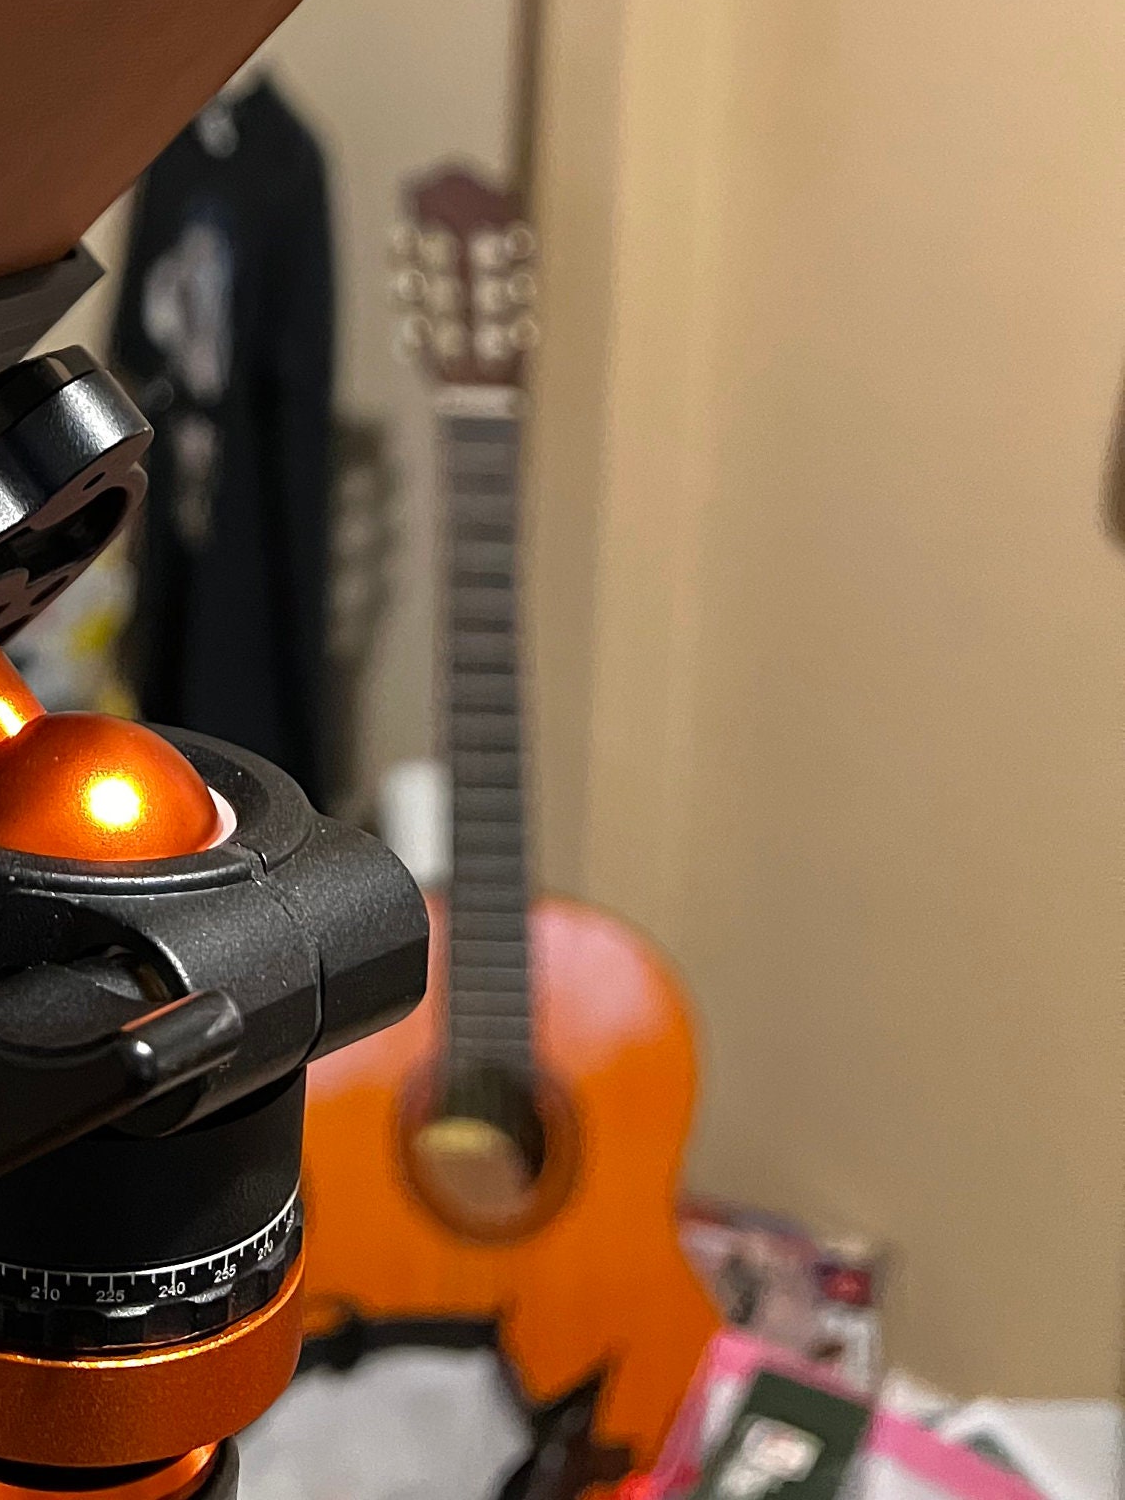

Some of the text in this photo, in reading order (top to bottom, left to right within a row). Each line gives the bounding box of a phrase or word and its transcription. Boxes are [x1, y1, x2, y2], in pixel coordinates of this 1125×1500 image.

[30, 1286, 61, 1301] 210
[95, 1289, 125, 1303] 225
[158, 1281, 186, 1298] 240
[214, 1263, 237, 1283] 255
